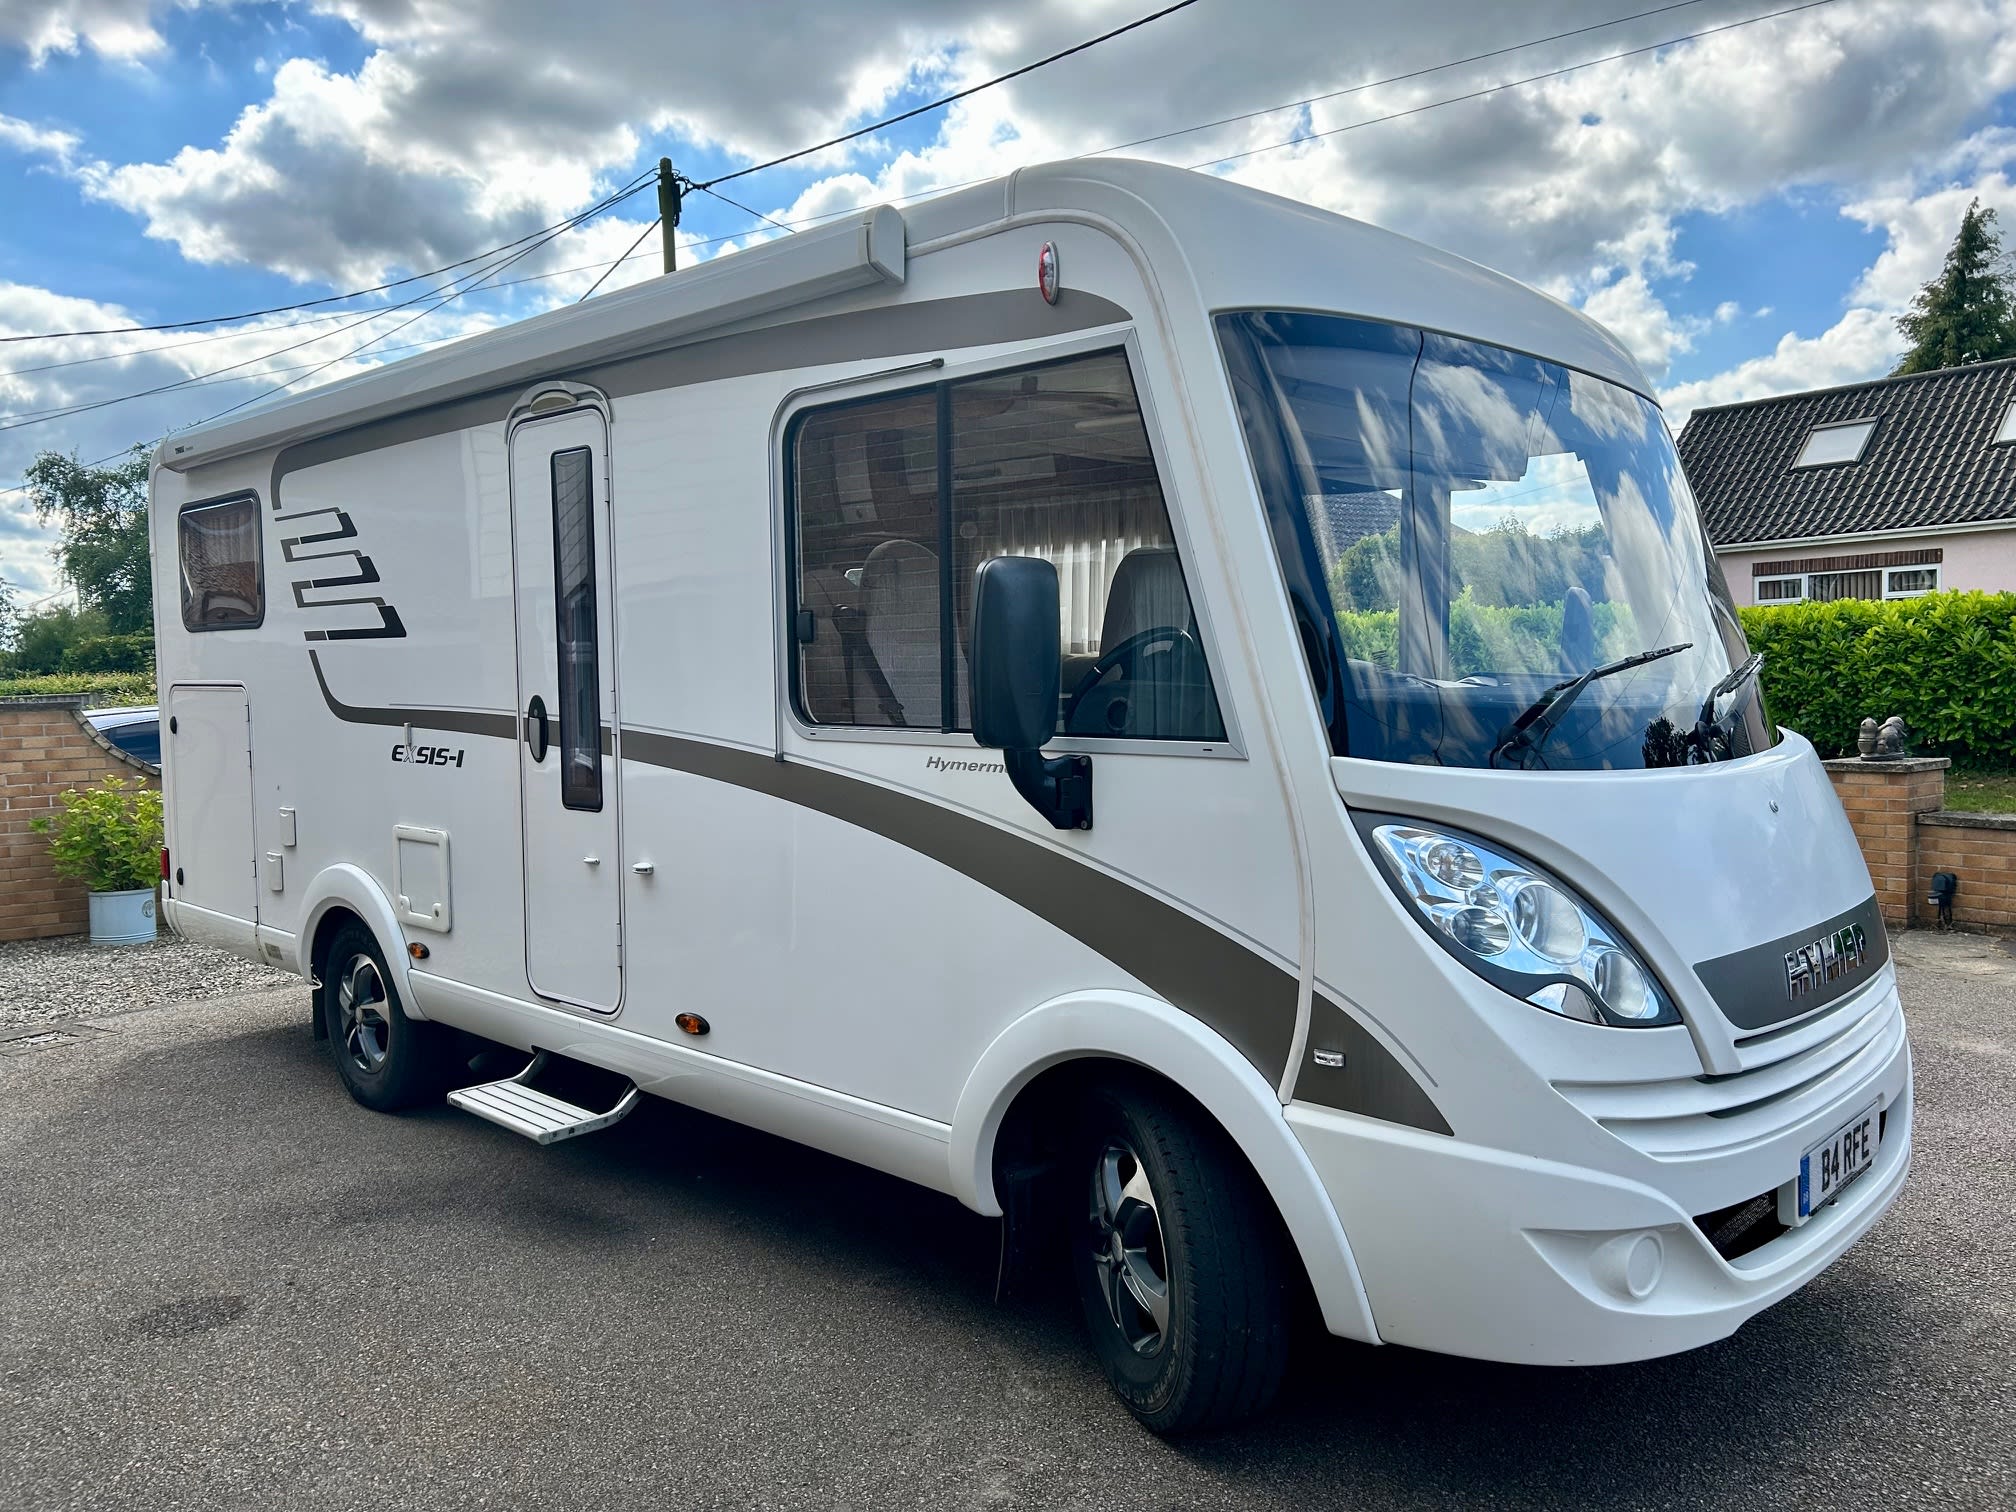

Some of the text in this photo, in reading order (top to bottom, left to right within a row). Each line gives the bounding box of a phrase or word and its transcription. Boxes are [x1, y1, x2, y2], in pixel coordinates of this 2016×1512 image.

[926, 756, 1008, 774] Hymerm
[1784, 922, 1867, 1001] HYMER
[1822, 1118, 1870, 1193] B4 RFE
